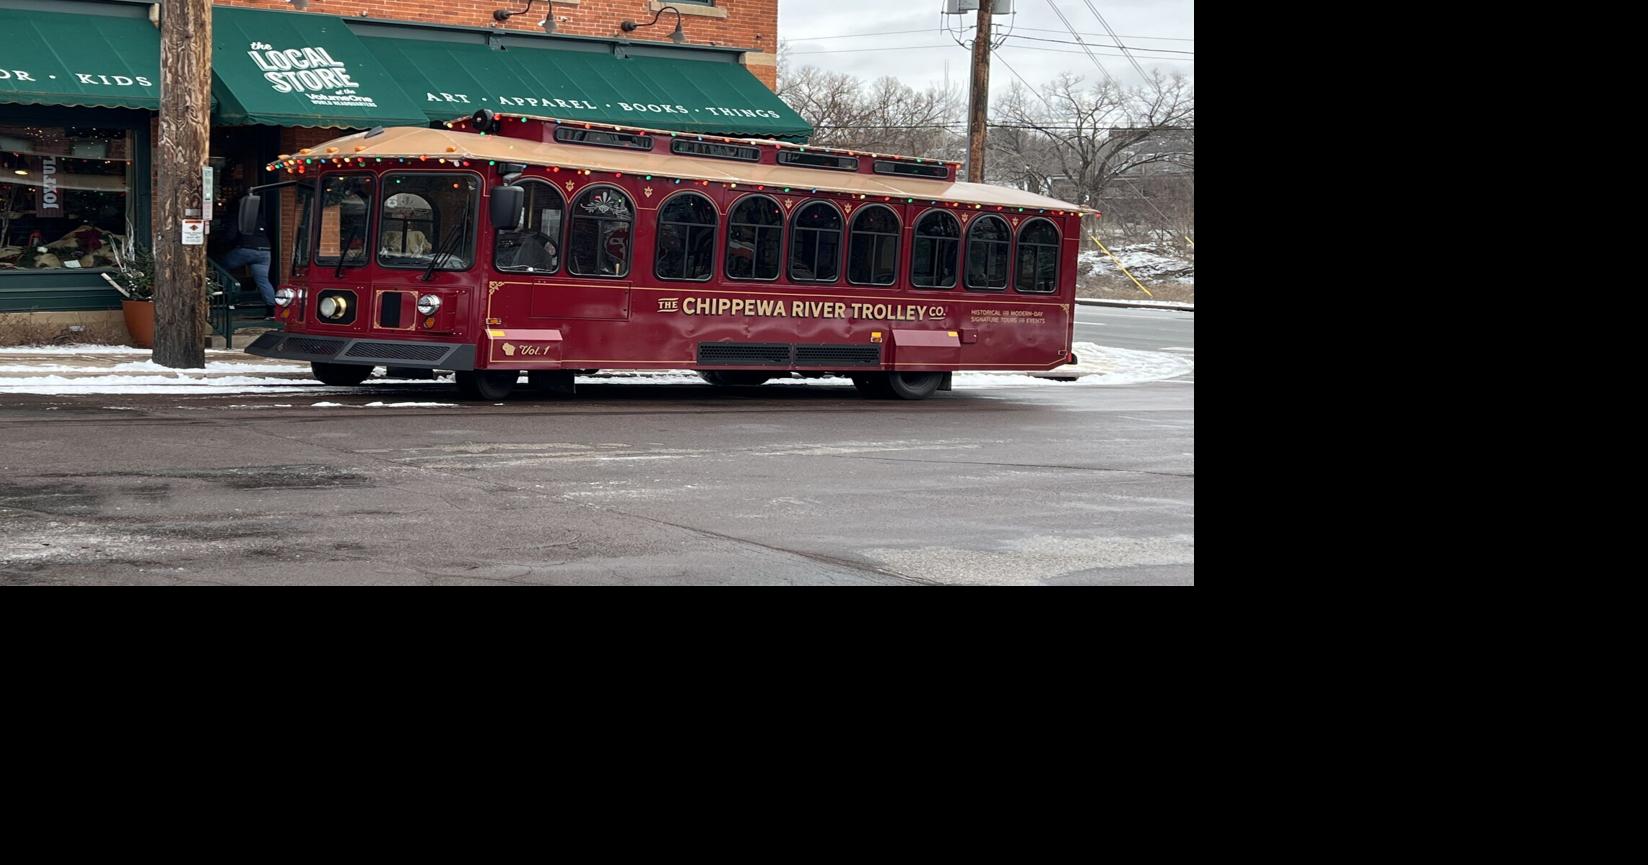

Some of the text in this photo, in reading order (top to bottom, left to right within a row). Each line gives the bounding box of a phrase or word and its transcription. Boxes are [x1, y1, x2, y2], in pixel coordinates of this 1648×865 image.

[250, 41, 273, 50] the
[247, 46, 345, 71] LOCAL
[75, 72, 152, 86] KIDS
[263, 67, 360, 93] STORE
[426, 92, 780, 119] ART APPAREL BOOKS THINGS
[43, 155, 59, 209] JOYFUL
[658, 297, 946, 321] THE CHIPPEWA RIVER TROLLEY CO.
[519, 344, 551, 356] Vol. 1
